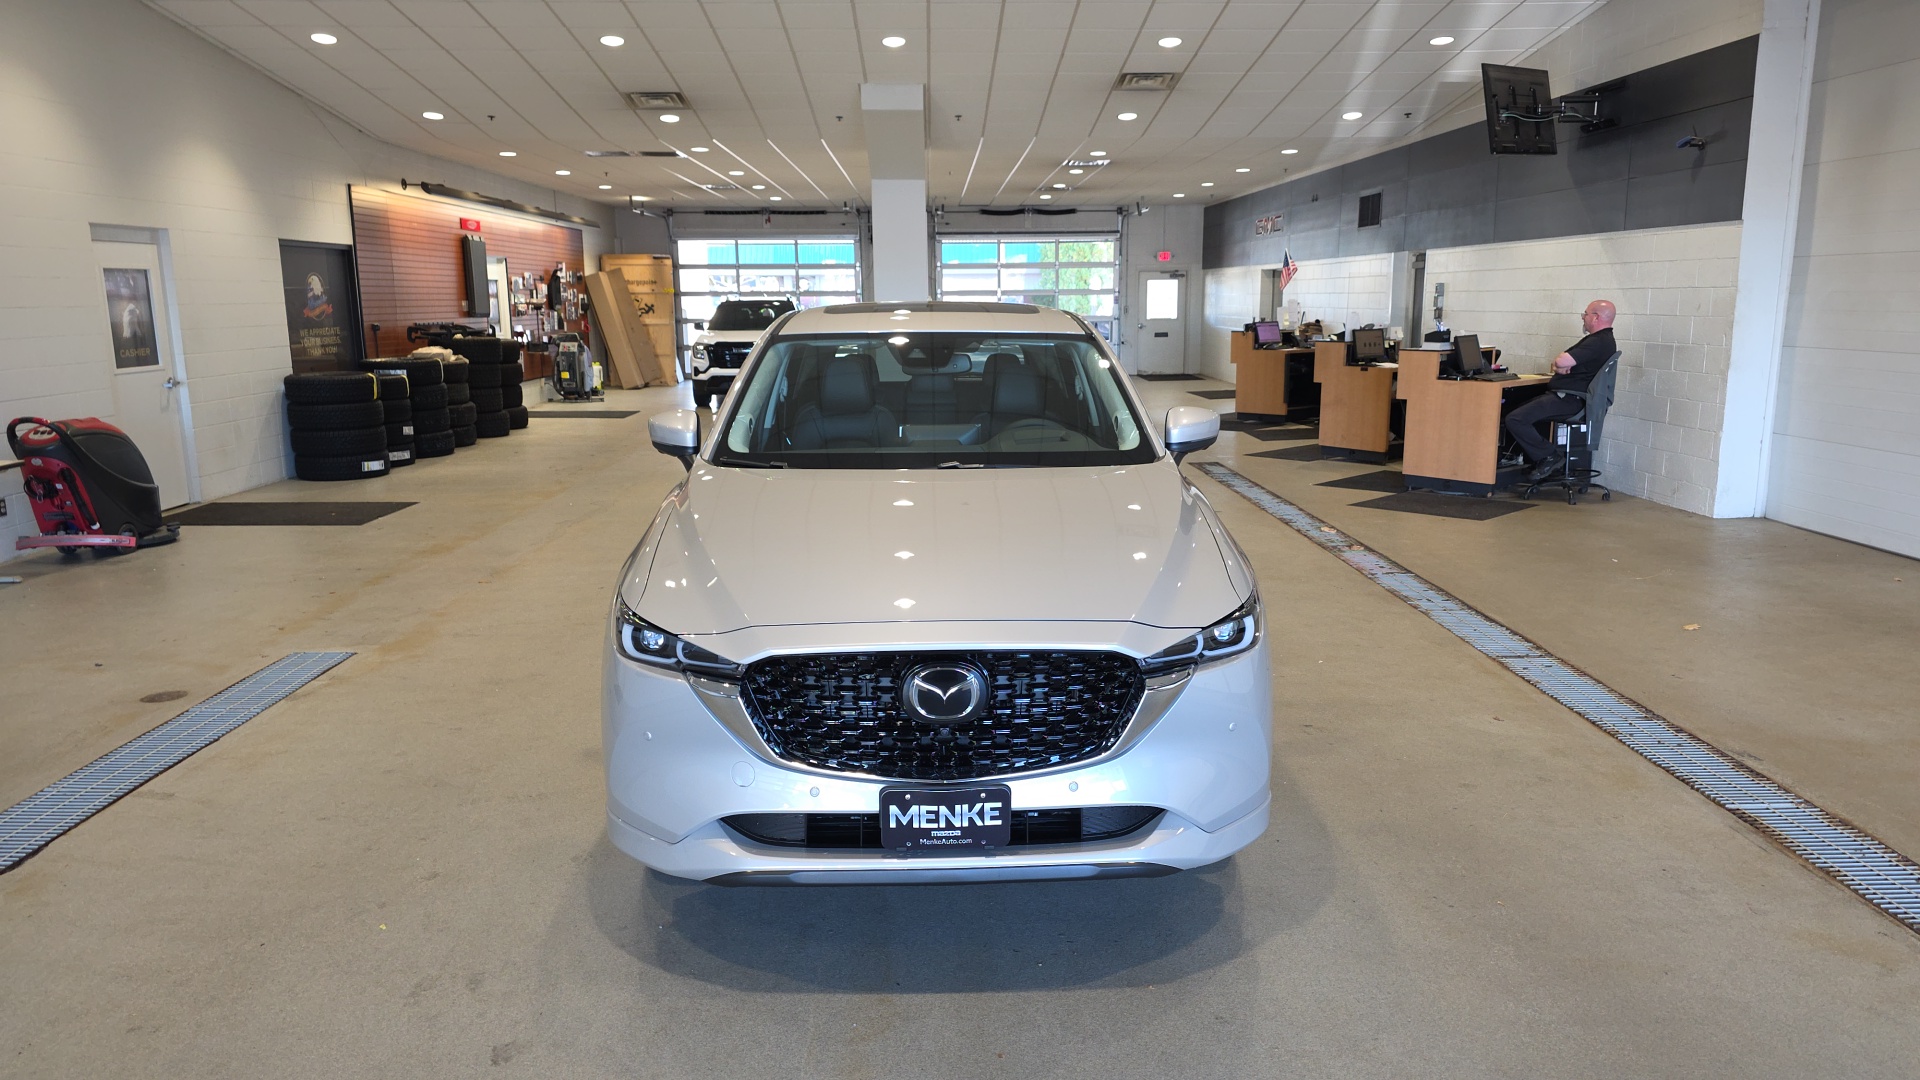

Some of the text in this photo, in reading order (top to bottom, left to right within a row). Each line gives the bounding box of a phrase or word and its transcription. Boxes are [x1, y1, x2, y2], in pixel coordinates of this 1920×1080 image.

[1255, 213, 1284, 236] GMC
[300, 326, 341, 337] WE APPRECIATE
[300, 337, 315, 347] YOUR
[120, 347, 151, 358] CASHIER
[307, 346, 325, 356] THANK
[889, 802, 1003, 829] MENKE
[919, 838, 973, 846] MenkeAuto.com
